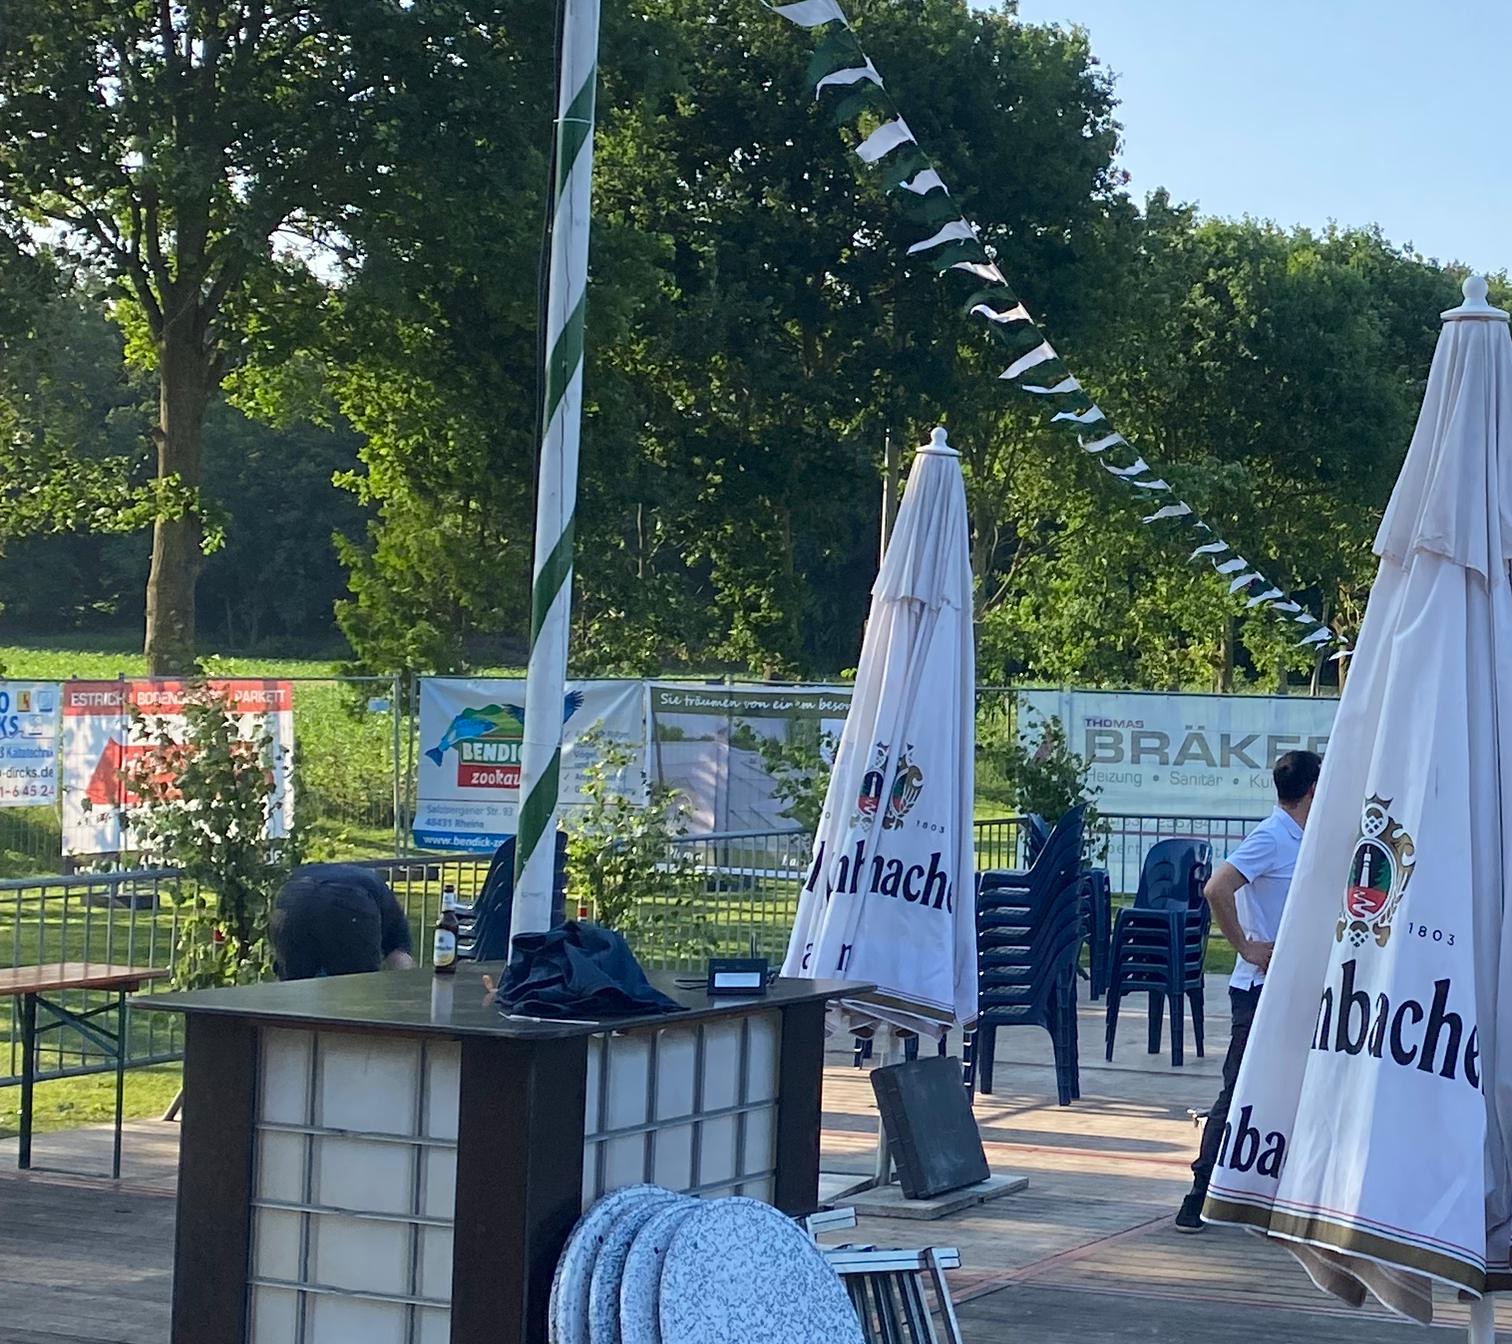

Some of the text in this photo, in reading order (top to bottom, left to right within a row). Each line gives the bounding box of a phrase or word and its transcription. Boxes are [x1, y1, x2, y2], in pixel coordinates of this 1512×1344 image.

[71, 692, 125, 707] ESTRICH
[234, 689, 286, 704] PARKETT
[661, 692, 680, 706] Sie
[684, 693, 740, 708] träumen
[744, 700, 770, 710] von
[1084, 718, 1145, 729] THOMAS
[0, 766, 54, 779] -dircks.de
[1087, 768, 1143, 786] Heizung
[1169, 771, 1223, 787] Sanitär
[915, 819, 945, 834] 1803
[1407, 921, 1456, 947] 1803
